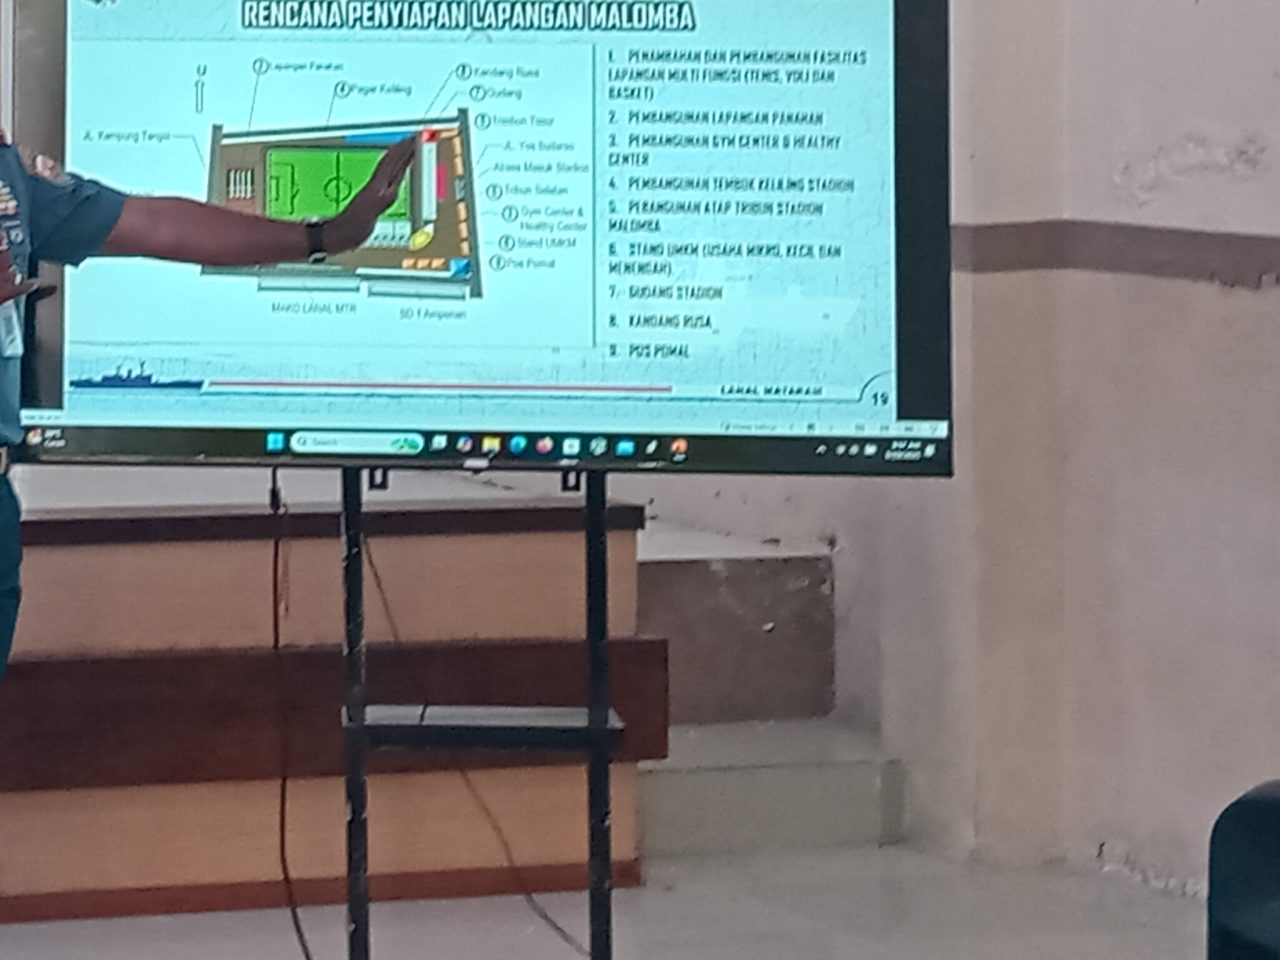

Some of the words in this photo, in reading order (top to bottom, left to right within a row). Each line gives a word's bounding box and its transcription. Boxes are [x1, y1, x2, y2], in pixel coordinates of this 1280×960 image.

[470, 0, 587, 31] LAPANGAN
[587, 0, 697, 31] MALOMBA
[813, 50, 867, 65] FASILITAS
[608, 67, 665, 82] LAPANGAN
[628, 109, 710, 125] PEMBANGUNAN
[712, 110, 769, 125] LAPANGAN
[771, 111, 823, 126] PANAHAN
[628, 133, 710, 149] PEMBANGUNAN
[712, 134, 737, 149] GYM
[738, 134, 780, 149] CENTER
[793, 135, 841, 150] HEALTHY
[608, 152, 650, 167] CENTER
[628, 176, 710, 191] PEMBANGUNAN
[712, 177, 755, 192] TEMBOK
[807, 178, 854, 193] STADION
[703, 201, 731, 215] ATAP
[735, 201, 773, 216] TRIBUN
[776, 201, 823, 216] STADION
[608, 219, 661, 233] MALOMBA
[628, 242, 664, 257] STAND
[628, 285, 673, 299] GUDANG
[676, 285, 723, 300] STADION
[628, 314, 680, 329] KANDANG
[683, 315, 712, 329] RUSA
[628, 343, 651, 358] POS
[653, 344, 689, 359] POMAL
[720, 384, 760, 395] LANAL
[763, 385, 823, 396] MATARAM
